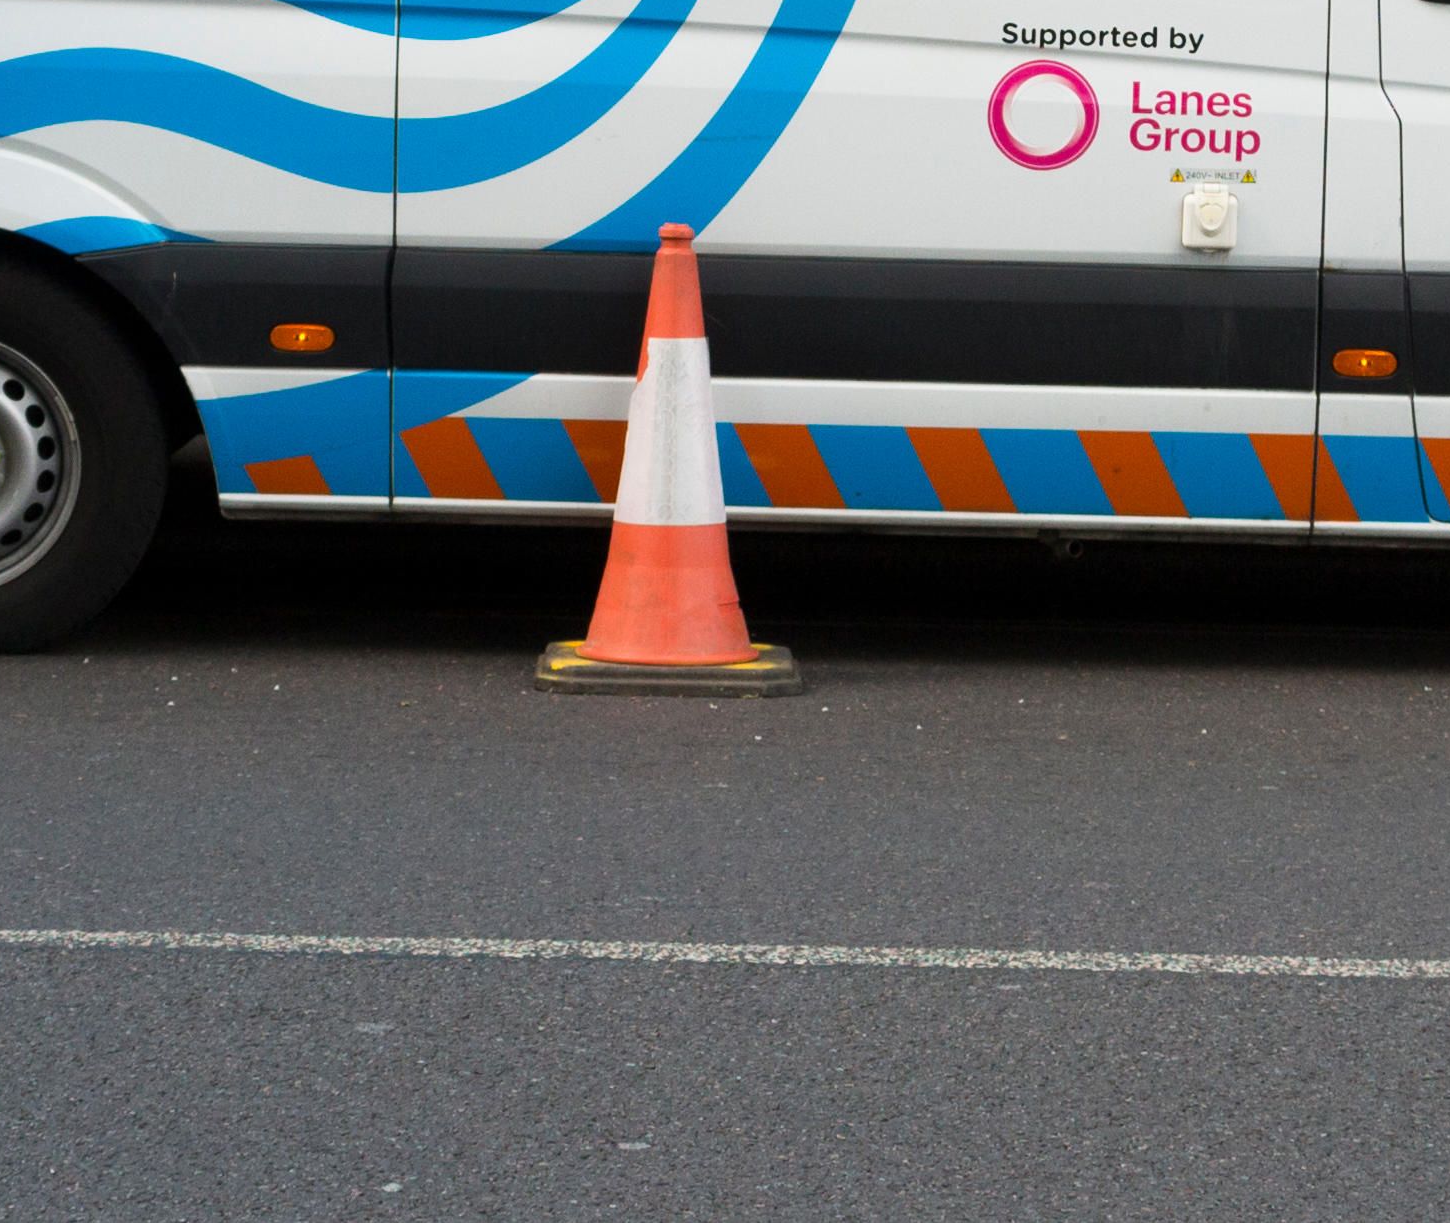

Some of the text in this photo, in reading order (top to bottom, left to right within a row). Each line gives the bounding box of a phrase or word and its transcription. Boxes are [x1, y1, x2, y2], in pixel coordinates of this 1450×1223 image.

[1002, 23, 1203, 53] Supported by
[1132, 82, 1251, 117] Lanes
[1130, 118, 1260, 161] Group
